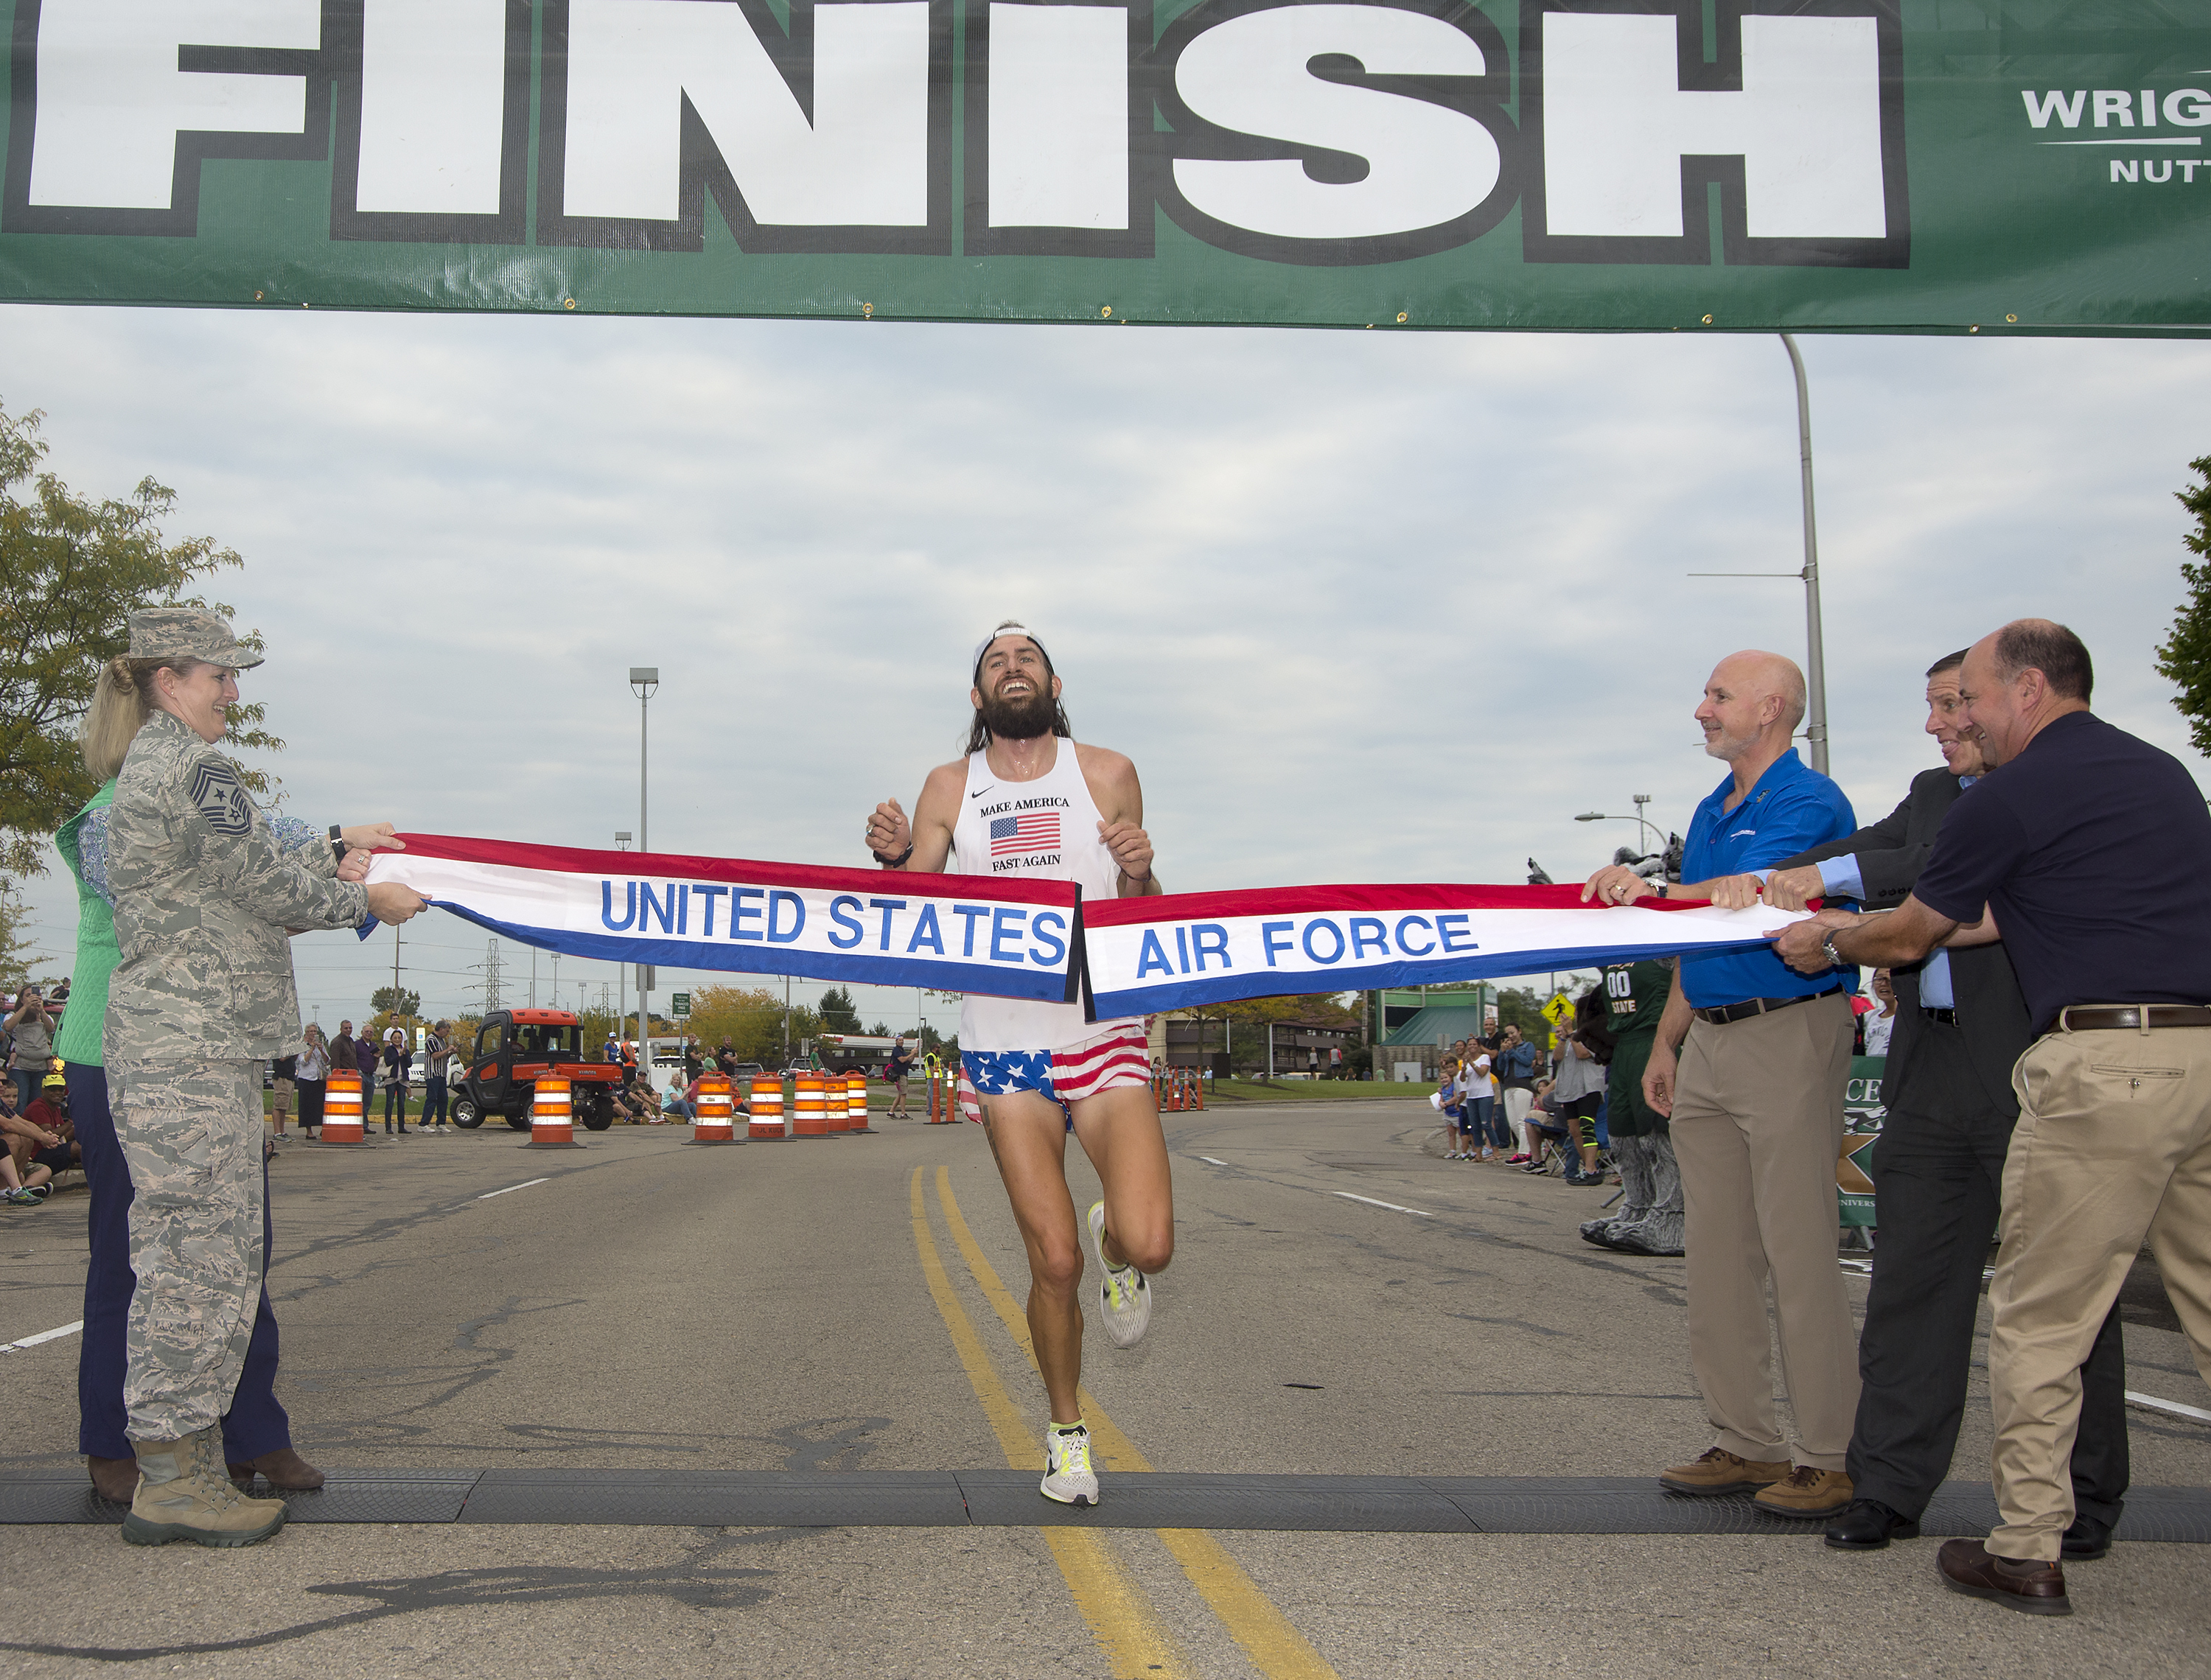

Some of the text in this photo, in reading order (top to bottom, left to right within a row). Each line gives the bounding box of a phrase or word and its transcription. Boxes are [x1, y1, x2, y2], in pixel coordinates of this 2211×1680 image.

[28, 0, 1887, 240] FINISH
[2022, 88, 2211, 128] WRIG
[979, 797, 1070, 818] MAKE AMERICA
[992, 855, 1061, 872] FAST AGAIN
[601, 881, 1479, 979] UNITED STATES AIR FORCE
[1607, 970, 1631, 998] 00
[1612, 999, 1636, 1013] STATE
